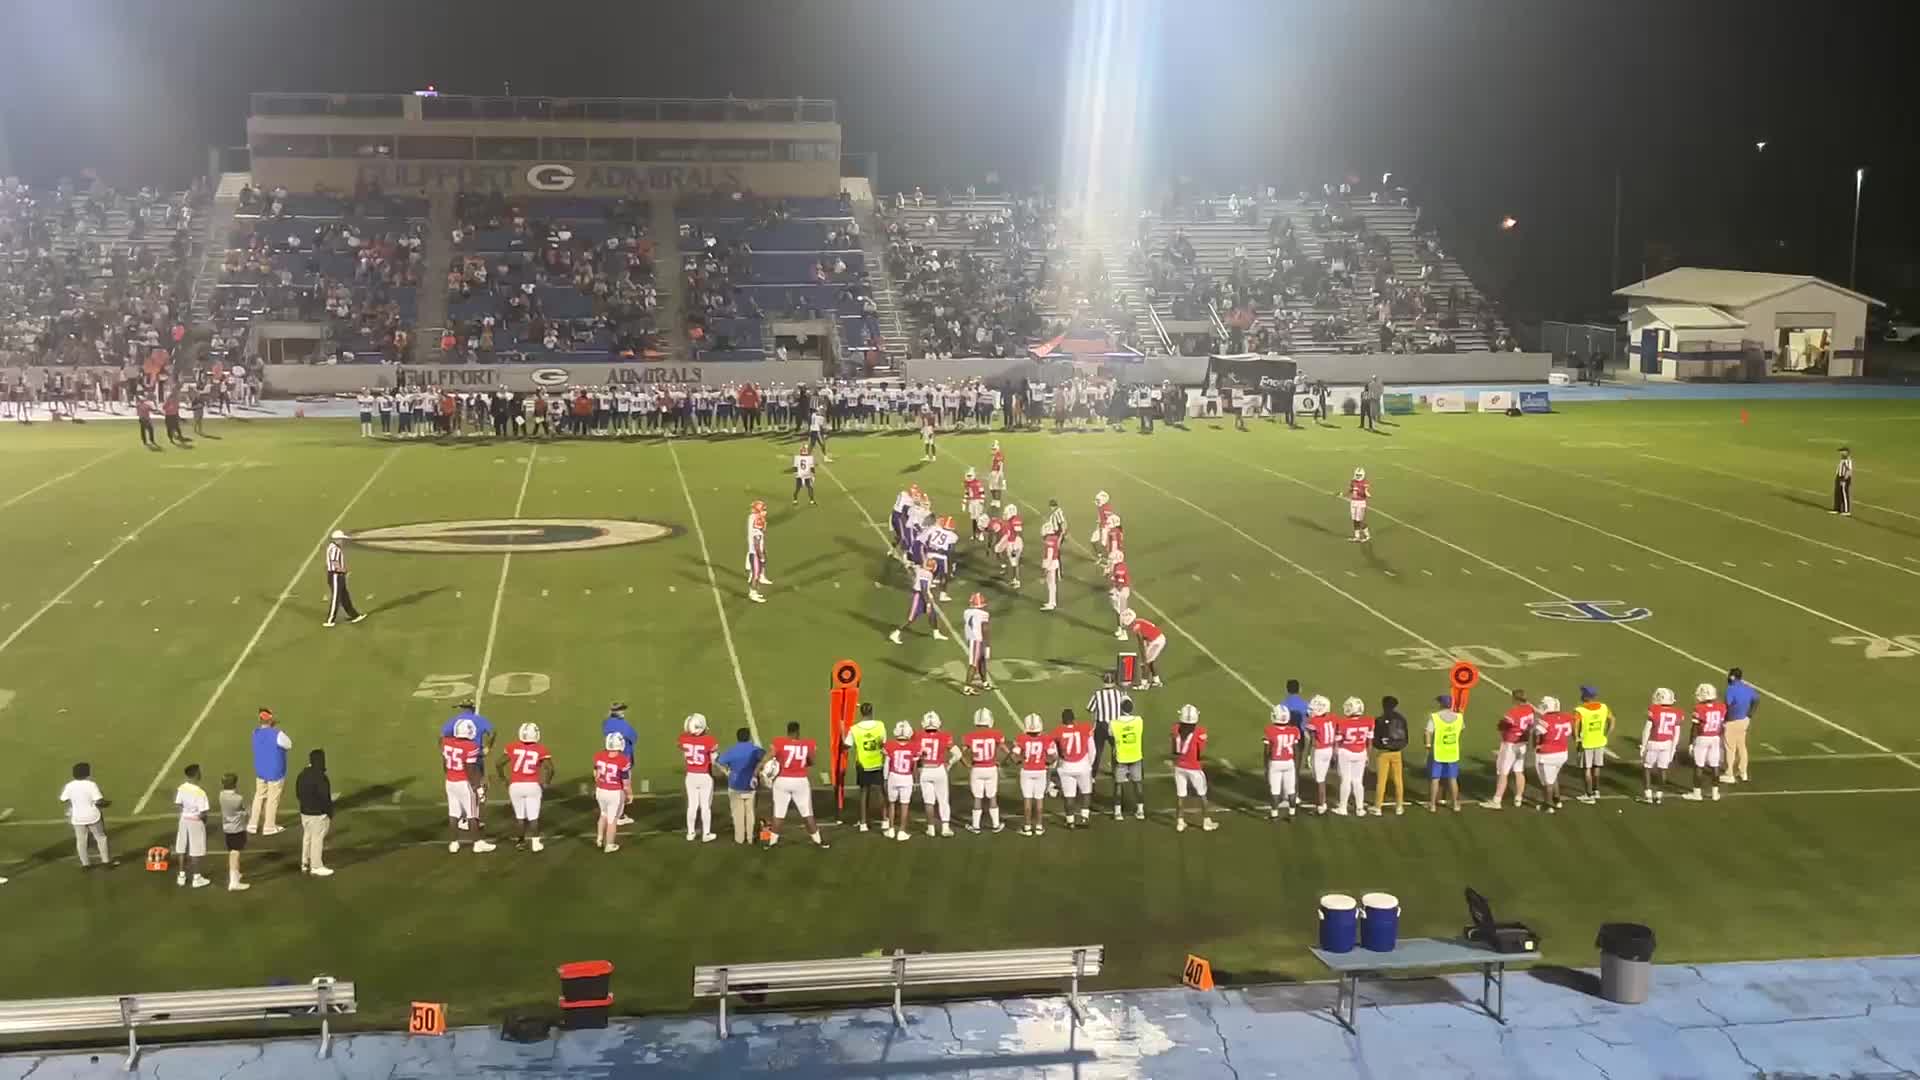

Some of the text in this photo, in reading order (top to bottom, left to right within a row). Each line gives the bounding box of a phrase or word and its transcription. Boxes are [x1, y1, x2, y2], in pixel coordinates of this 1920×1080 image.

[527, 163, 576, 191] G
[531, 368, 569, 385] G
[607, 368, 702, 385] ADMIRALS
[931, 530, 948, 546] 79
[1122, 655, 1134, 681] 1
[412, 671, 550, 698] 50
[1658, 711, 1677, 735] 12
[920, 738, 939, 760] 51
[972, 738, 995, 761] 50
[1062, 731, 1082, 754] 71
[442, 745, 463, 770] 55
[513, 748, 539, 774] 72
[784, 745, 808, 768] 74
[894, 750, 911, 773] 16
[1185, 959, 1203, 985] 40
[412, 1006, 435, 1031] 50
